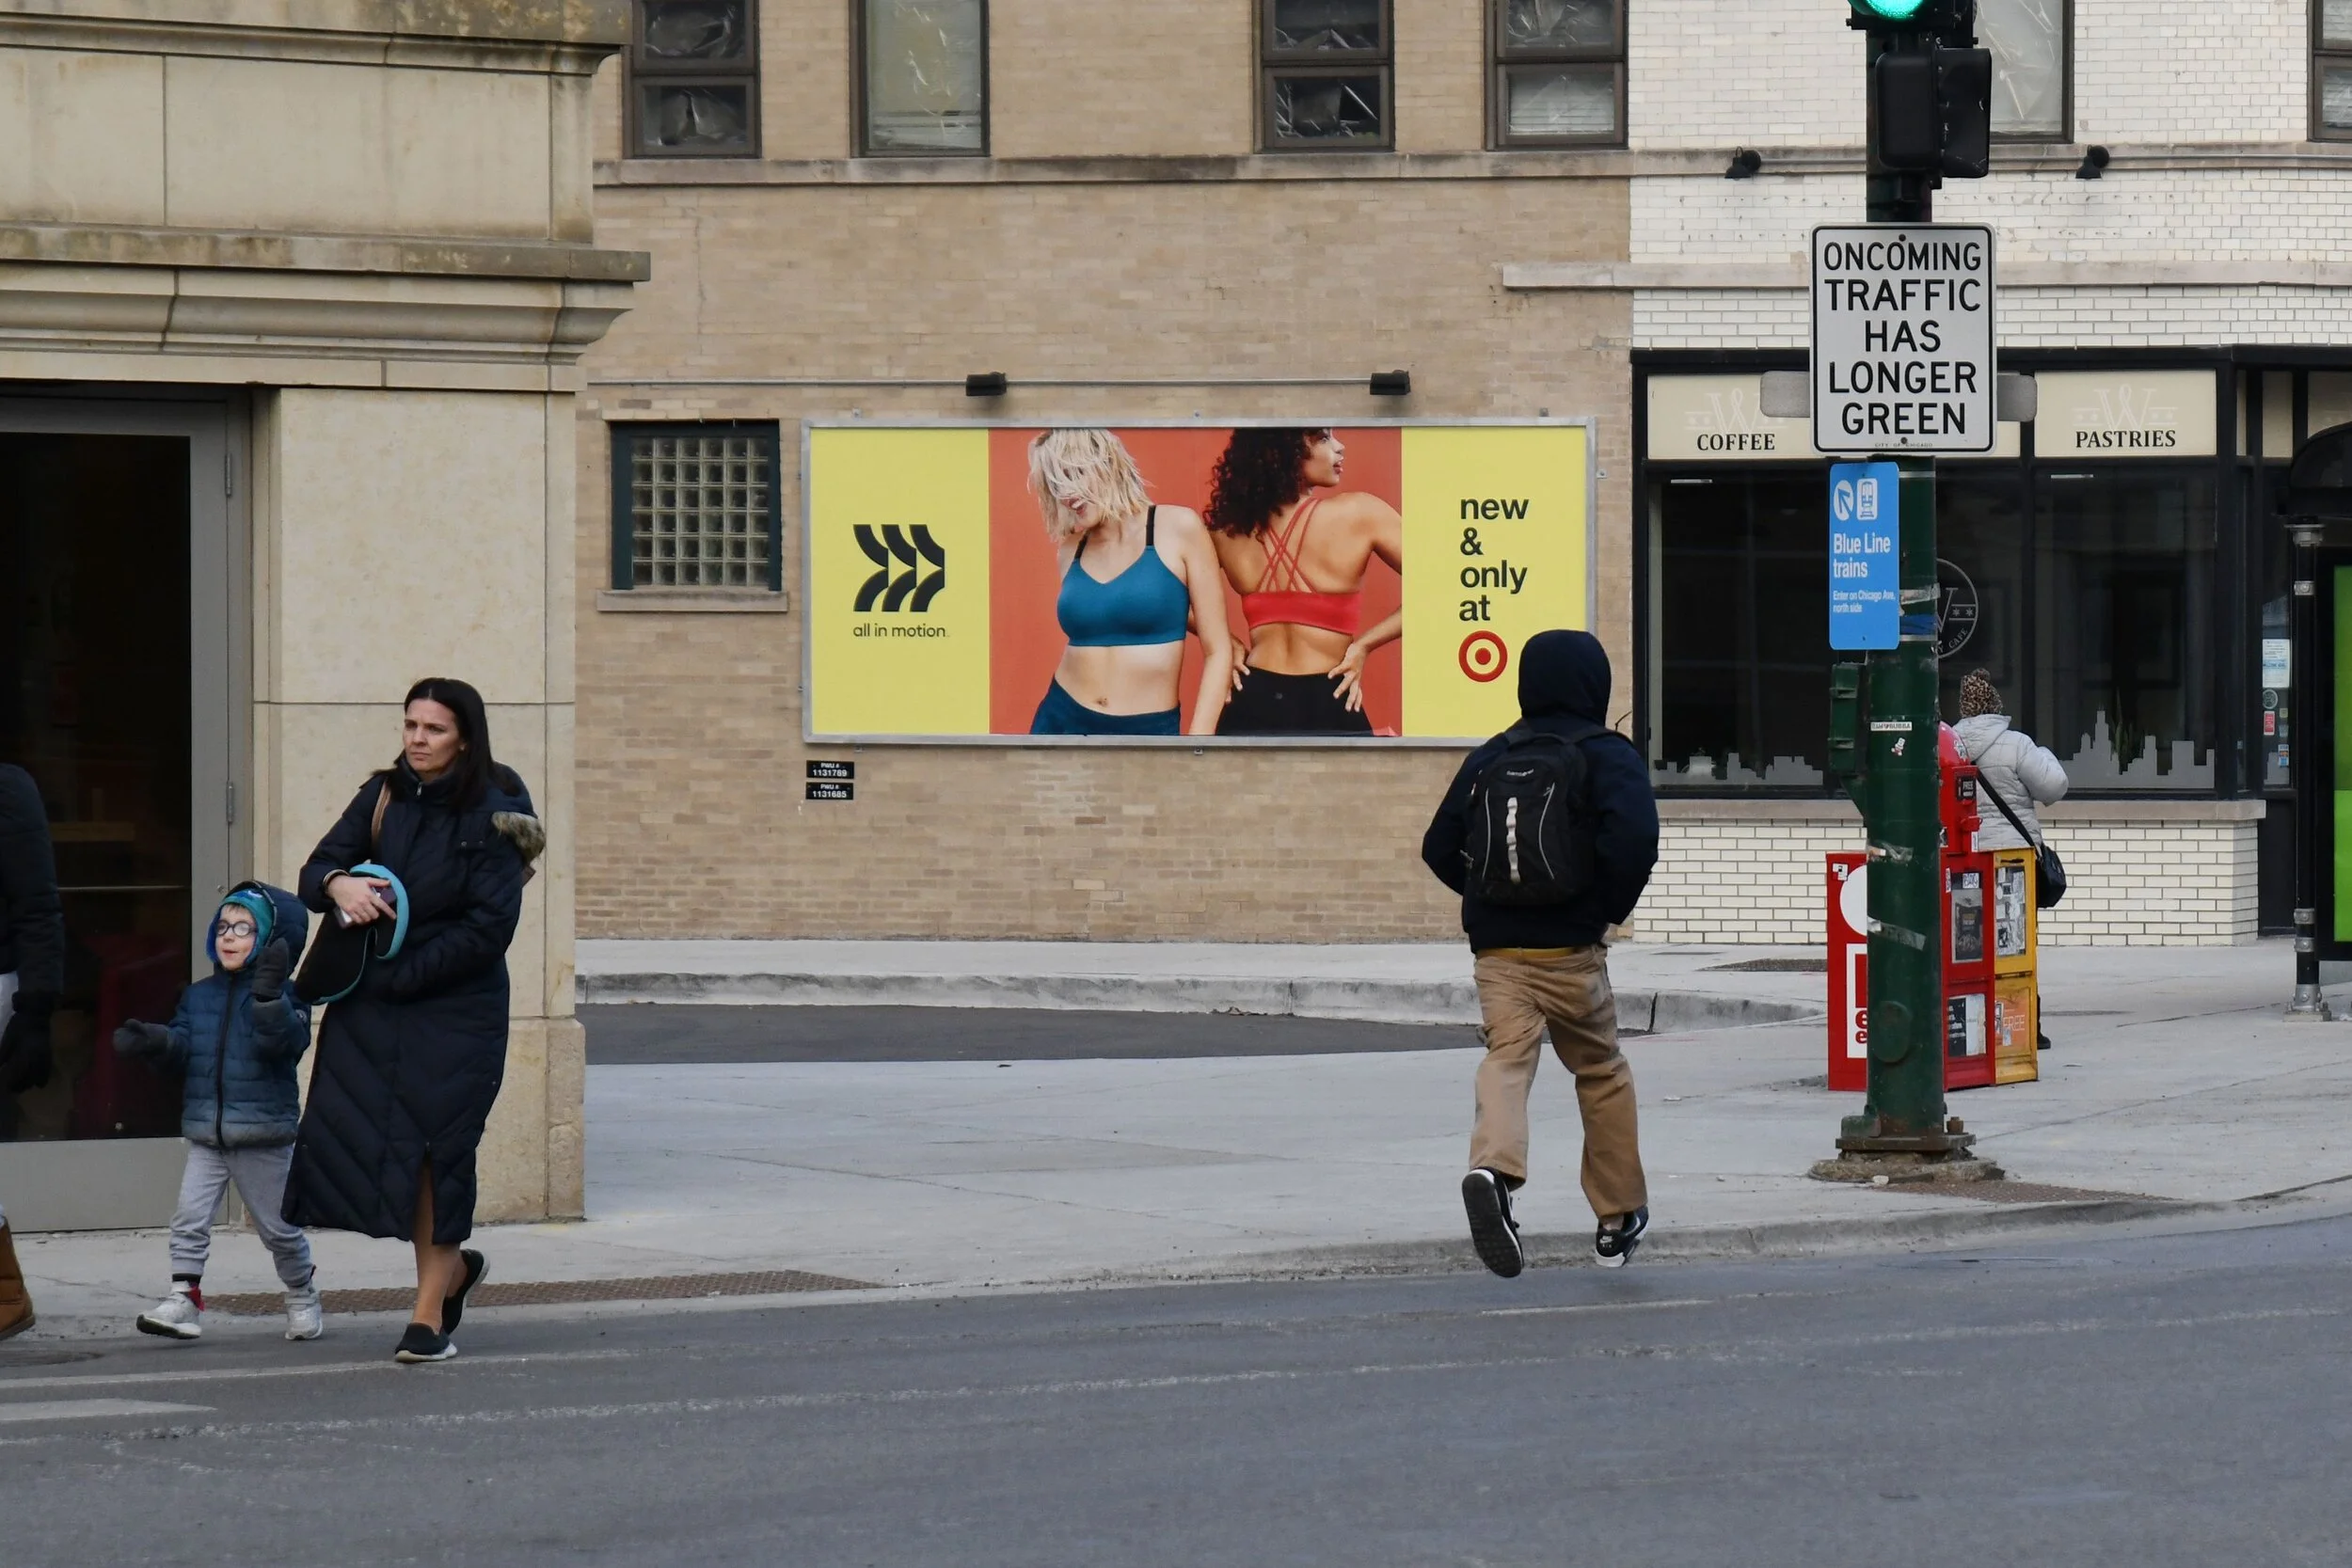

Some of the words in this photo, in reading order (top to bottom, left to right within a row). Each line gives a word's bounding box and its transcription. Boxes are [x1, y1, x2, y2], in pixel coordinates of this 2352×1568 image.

[1823, 241, 1981, 271] ONCOMING
[1823, 278, 1981, 311] TRAFFIC
[1865, 320, 1941, 353] HAS
[1829, 361, 1977, 393] LONGER
[1841, 402, 1965, 435] GREEN
[1696, 433, 1775, 451] COFFEE
[2075, 430, 2176, 448] PASTRIES
[1460, 499, 1530, 520] new
[1459, 527, 1484, 556] &
[1834, 532, 1862, 554] Blue
[1864, 531, 1891, 554] Line
[1460, 560, 1528, 594] only
[1833, 557, 1867, 578] trains
[1459, 594, 1491, 622] at
[1833, 590, 1849, 600] Enter
[1850, 592, 1857, 600] on
[1858, 590, 1883, 602] Chicago
[1833, 603, 1849, 612] north
[1850, 602, 1863, 612] side
[853, 623, 870, 637] all
[874, 623, 888, 637] in
[892, 623, 946, 637] motion
